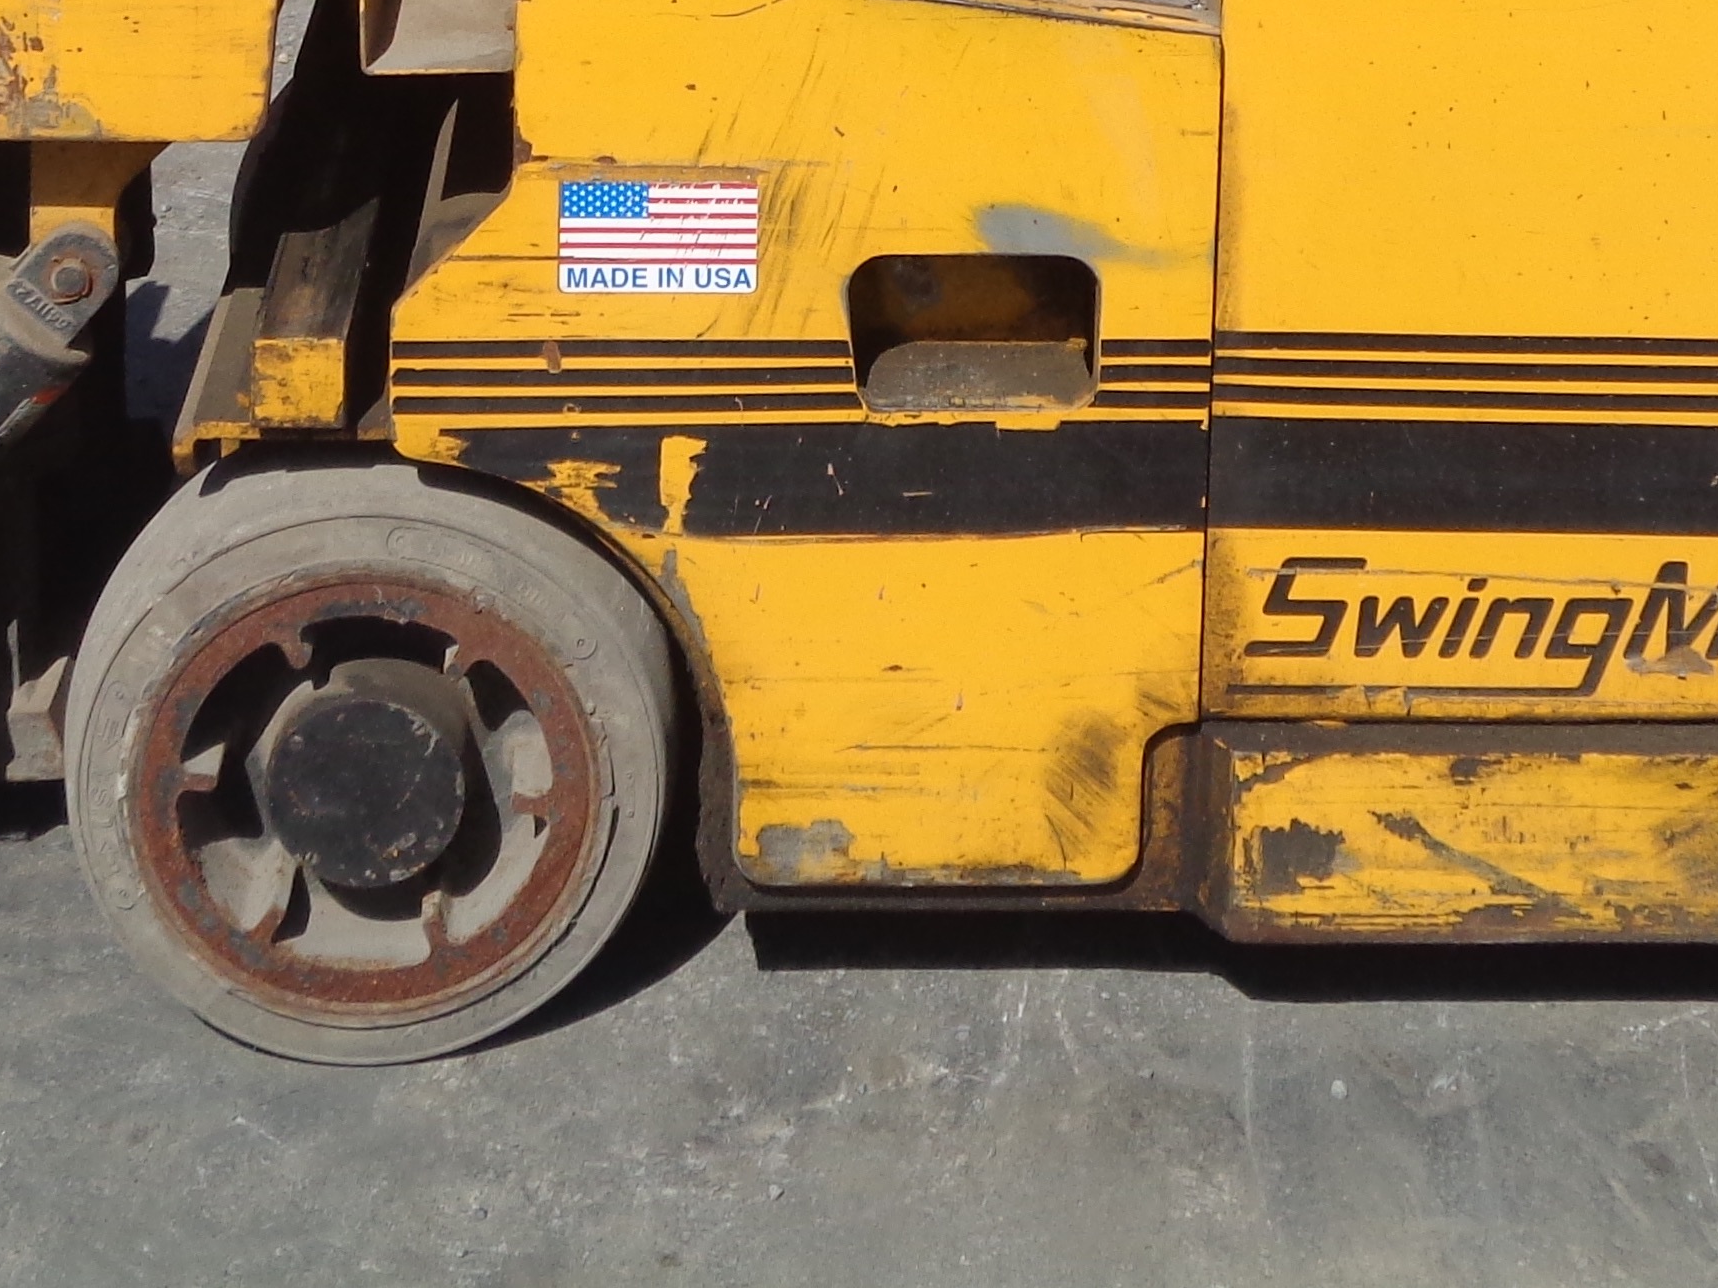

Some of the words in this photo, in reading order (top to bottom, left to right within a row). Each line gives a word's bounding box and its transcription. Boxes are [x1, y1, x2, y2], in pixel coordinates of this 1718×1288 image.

[566, 268, 648, 289] MADE
[658, 268, 684, 288] IN
[694, 268, 752, 289] USA
